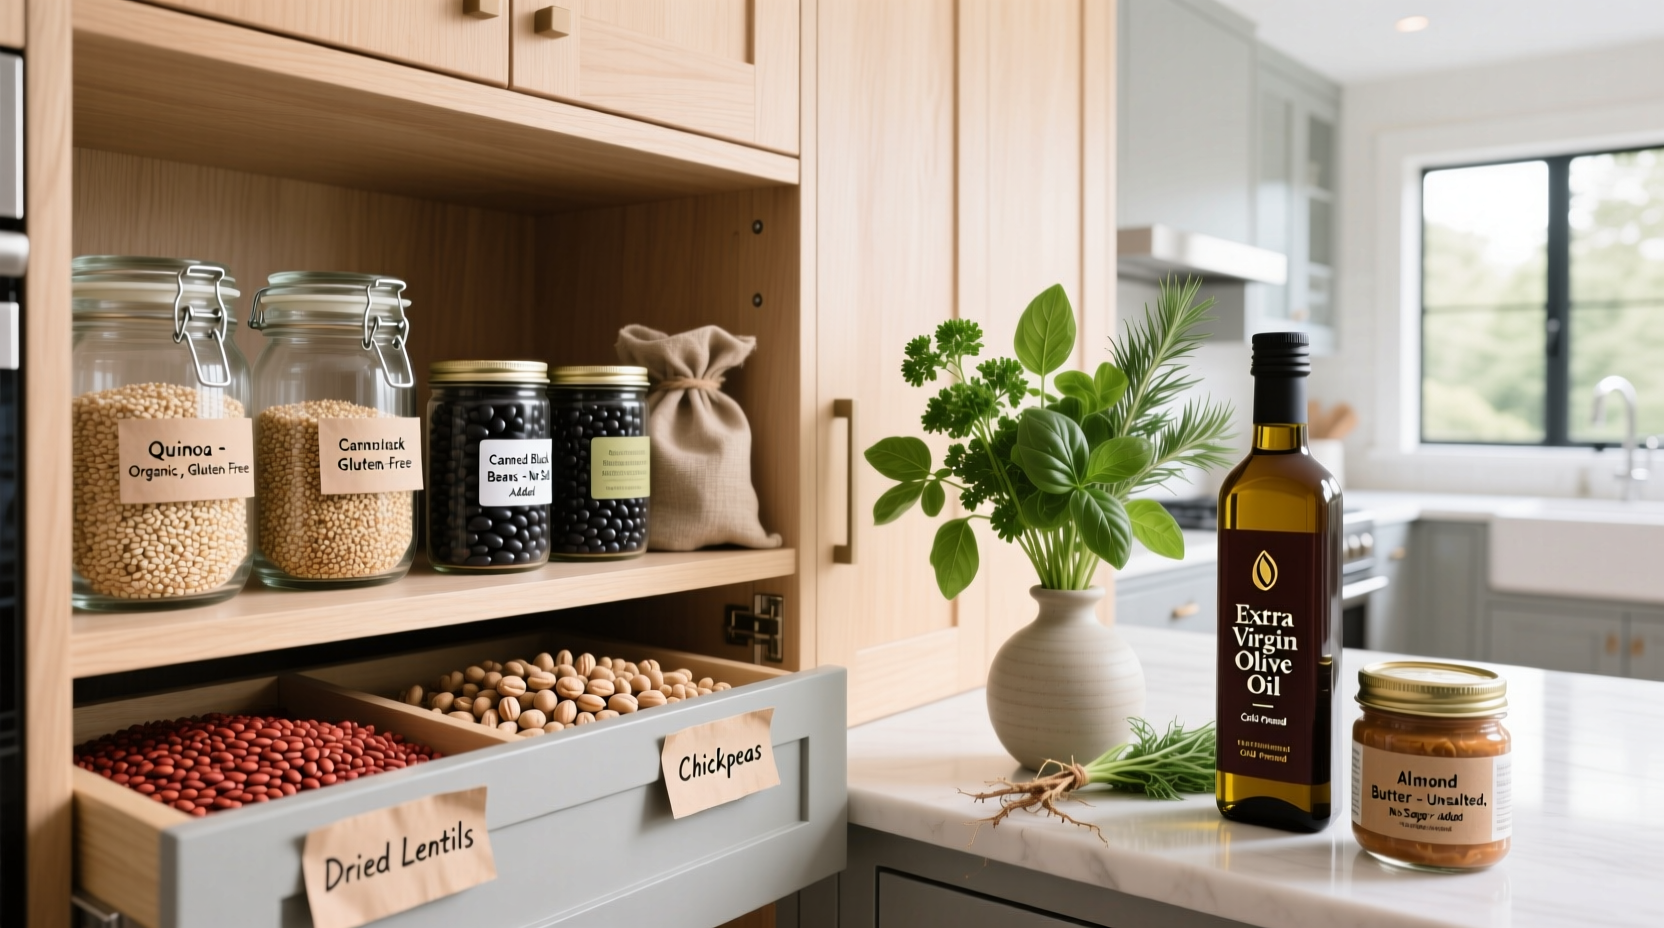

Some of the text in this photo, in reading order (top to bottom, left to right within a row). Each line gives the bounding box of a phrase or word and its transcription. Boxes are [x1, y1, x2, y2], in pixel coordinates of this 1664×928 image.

[148, 440, 213, 461] Quinoa
[187, 462, 226, 476] Gluten
[228, 461, 250, 475] Free
[1234, 603, 1295, 628] Extra
[1231, 626, 1299, 655] Virgin
[1234, 650, 1294, 674] Olive
[1246, 674, 1281, 696] Oil
[678, 744, 762, 782] Chickpeas
[1396, 770, 1458, 789] Almond
[1371, 784, 1413, 803] Butter
[324, 820, 475, 893] Dried Lentils
